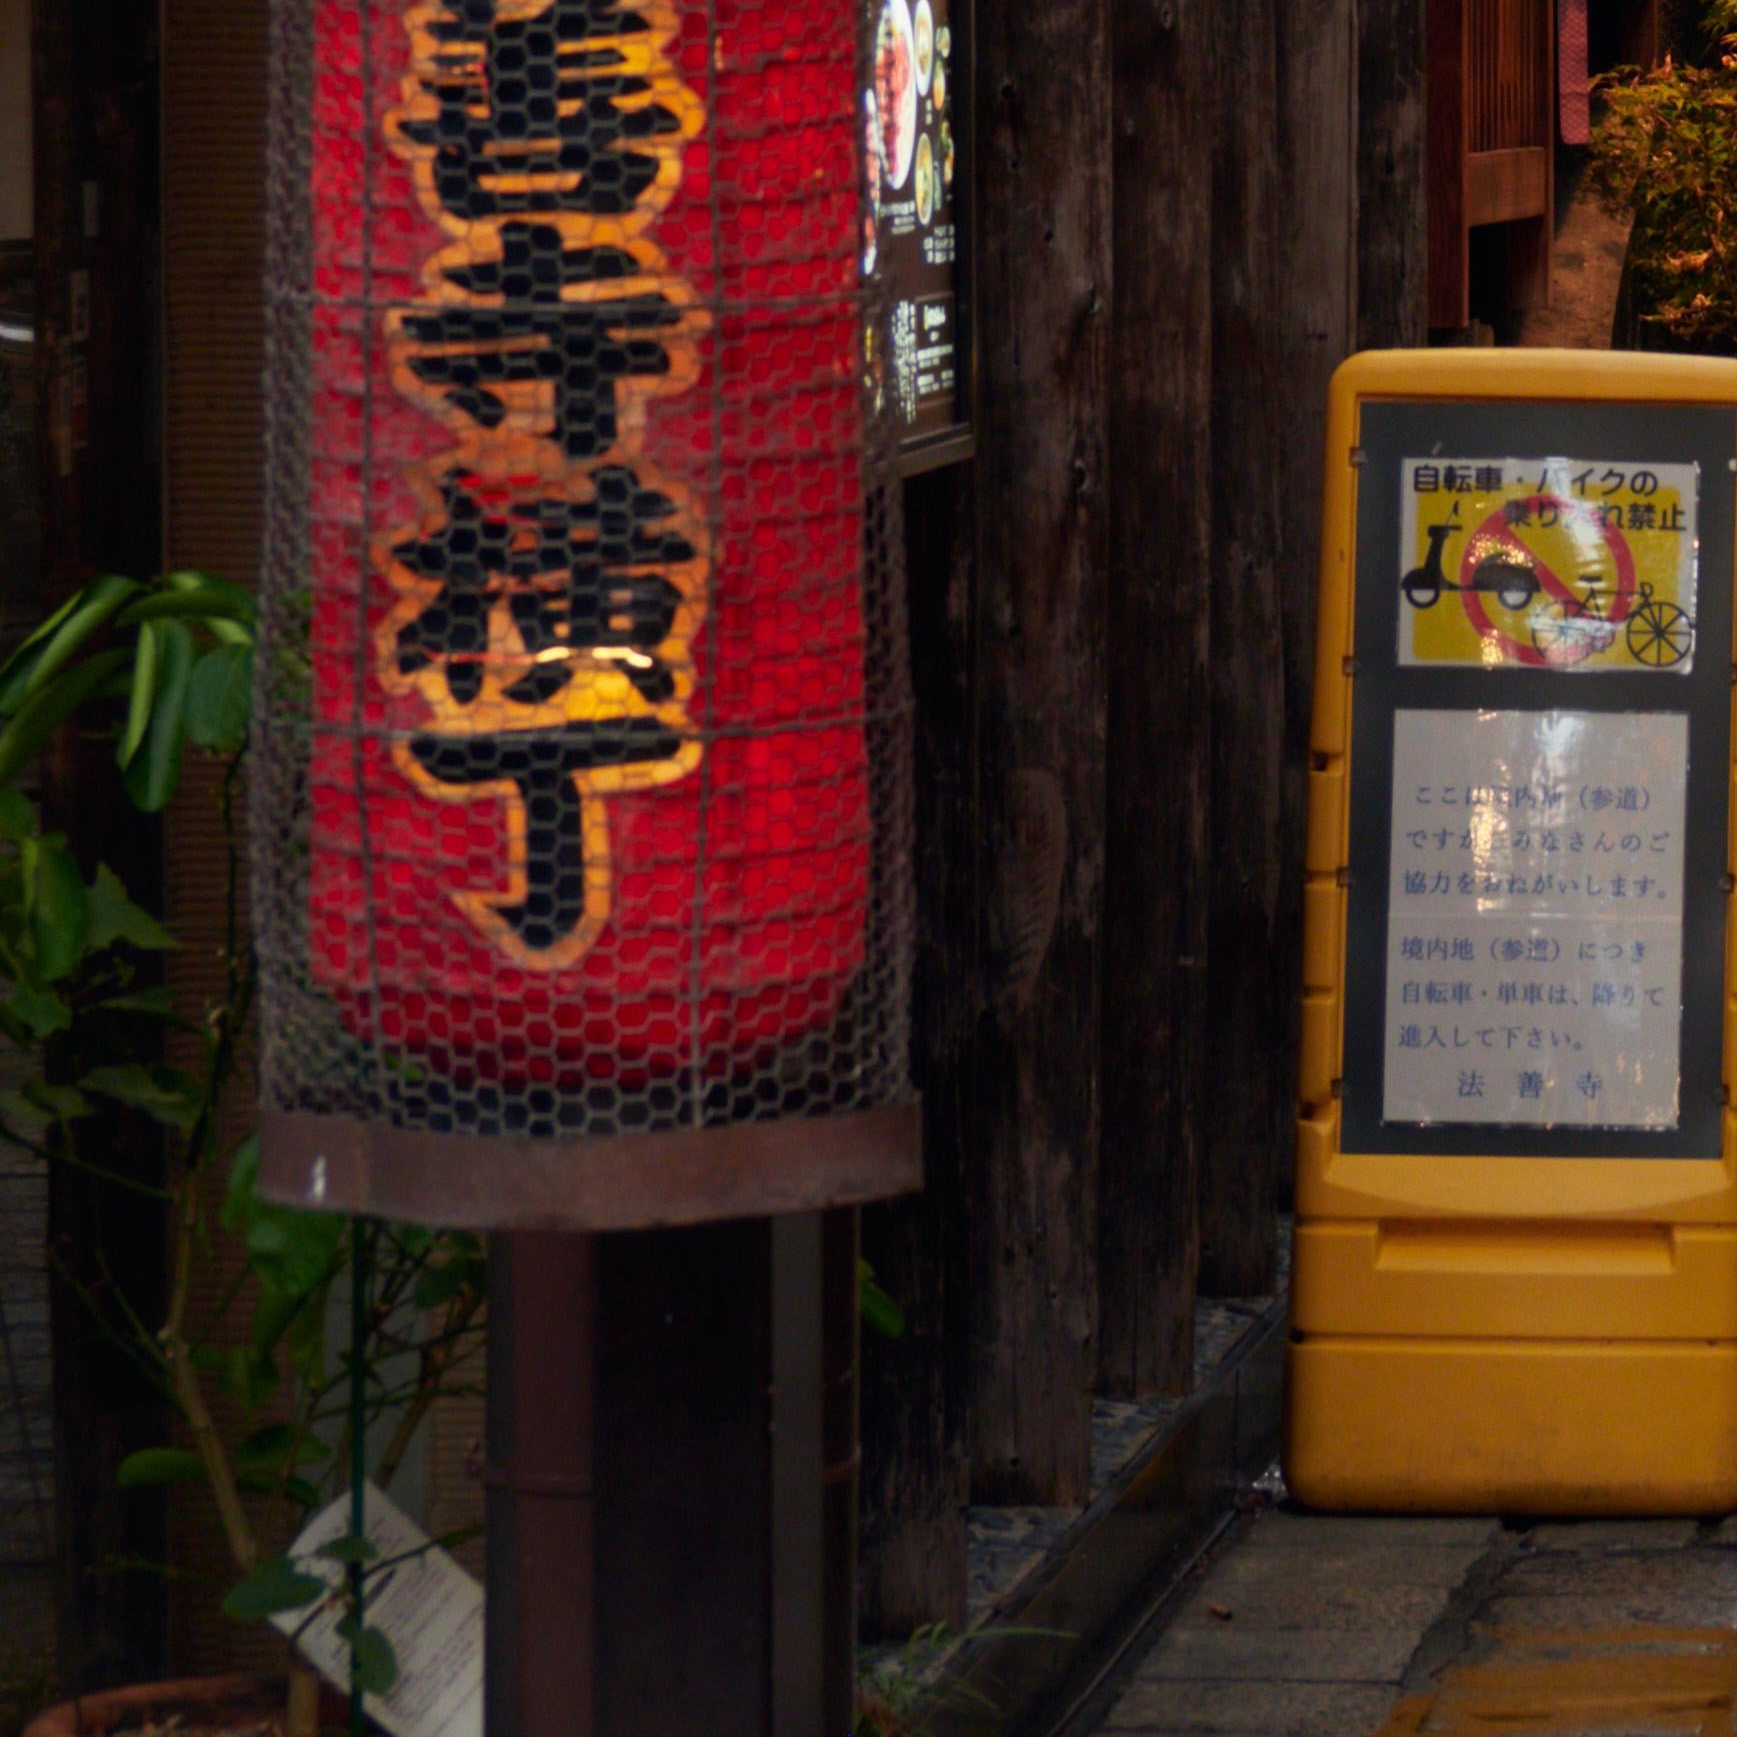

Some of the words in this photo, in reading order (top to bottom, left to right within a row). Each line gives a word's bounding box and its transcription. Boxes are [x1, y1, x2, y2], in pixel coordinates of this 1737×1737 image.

[1413, 464, 1660, 496] 自転車・バイクの
[1504, 499, 1688, 532] 乗りれ禁止
[1407, 829, 1672, 853] ですがみなさんのご
[1396, 1024, 1584, 1051] 進入して下さい。
[1457, 1070, 1603, 1099] 法善寺
